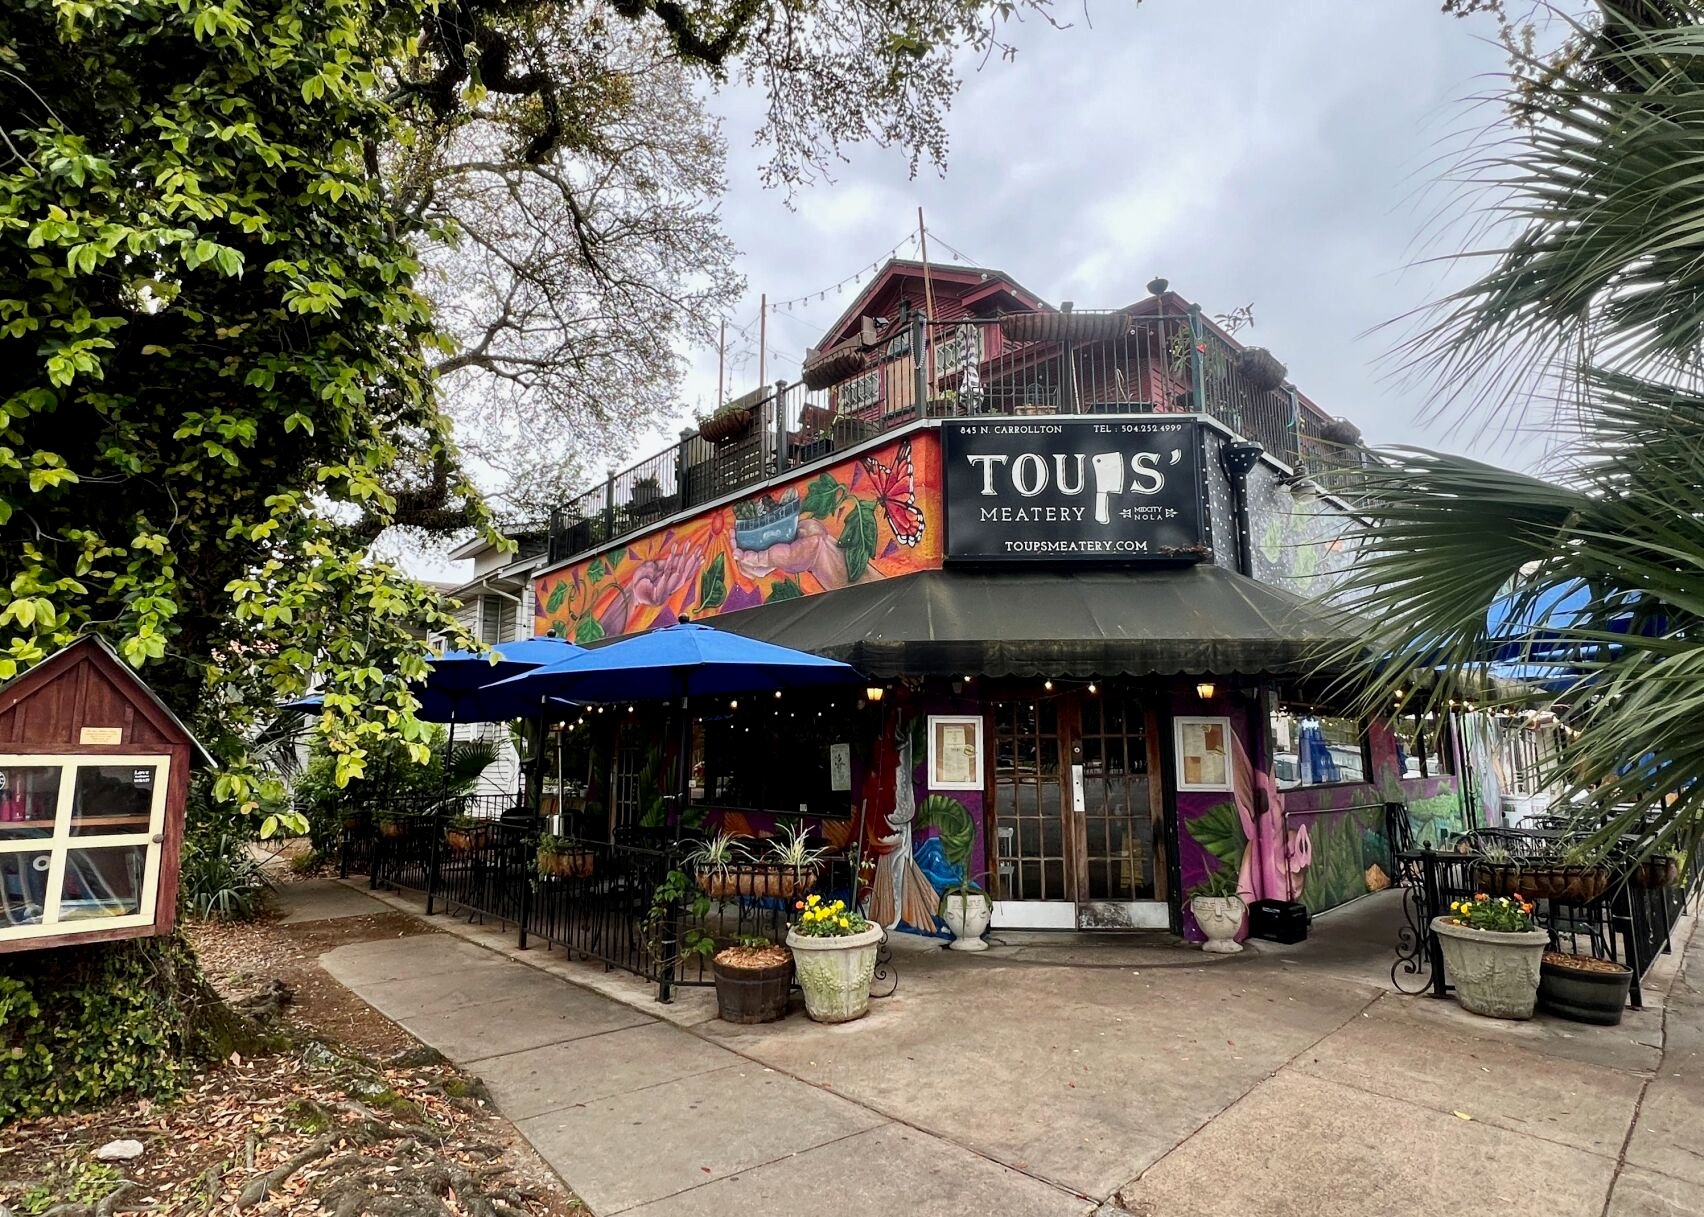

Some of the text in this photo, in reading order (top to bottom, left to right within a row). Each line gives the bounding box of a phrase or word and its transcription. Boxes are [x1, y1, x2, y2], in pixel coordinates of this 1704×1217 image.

[960, 425, 1063, 434] 845 N. CARROLLTON
[1121, 424, 1182, 433] 504.252.4999
[980, 507, 1086, 522] MEATERY
[1005, 541, 1148, 551] TOUPSMEATERY.COM
